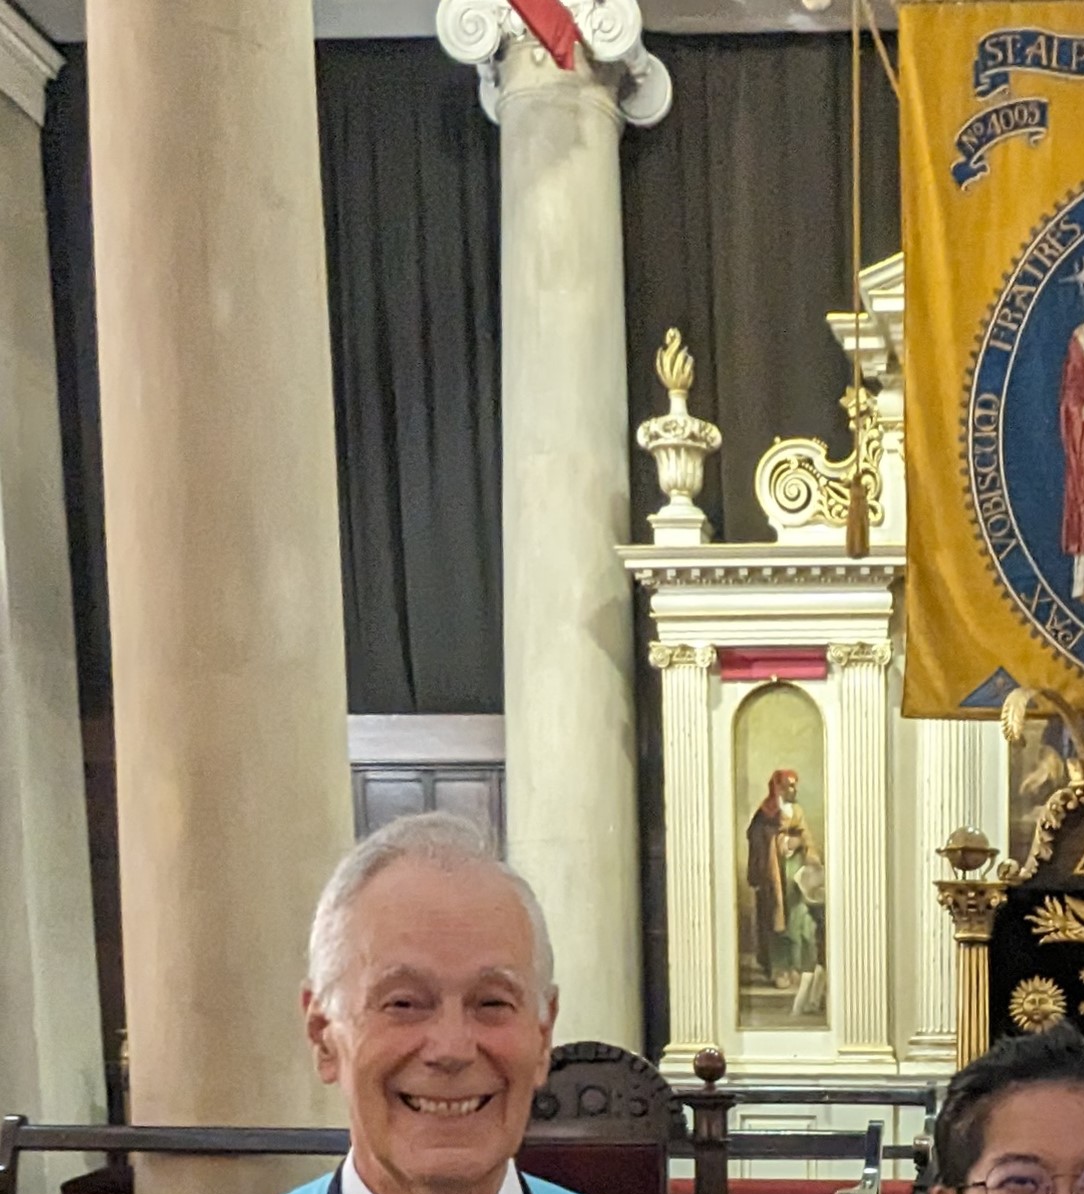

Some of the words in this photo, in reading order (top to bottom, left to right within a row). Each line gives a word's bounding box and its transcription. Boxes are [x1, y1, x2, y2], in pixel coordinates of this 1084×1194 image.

[989, 215, 1082, 351] FRATRES
[974, 392, 1017, 560] VOBISCUM
[1020, 583, 1084, 650] PAX
